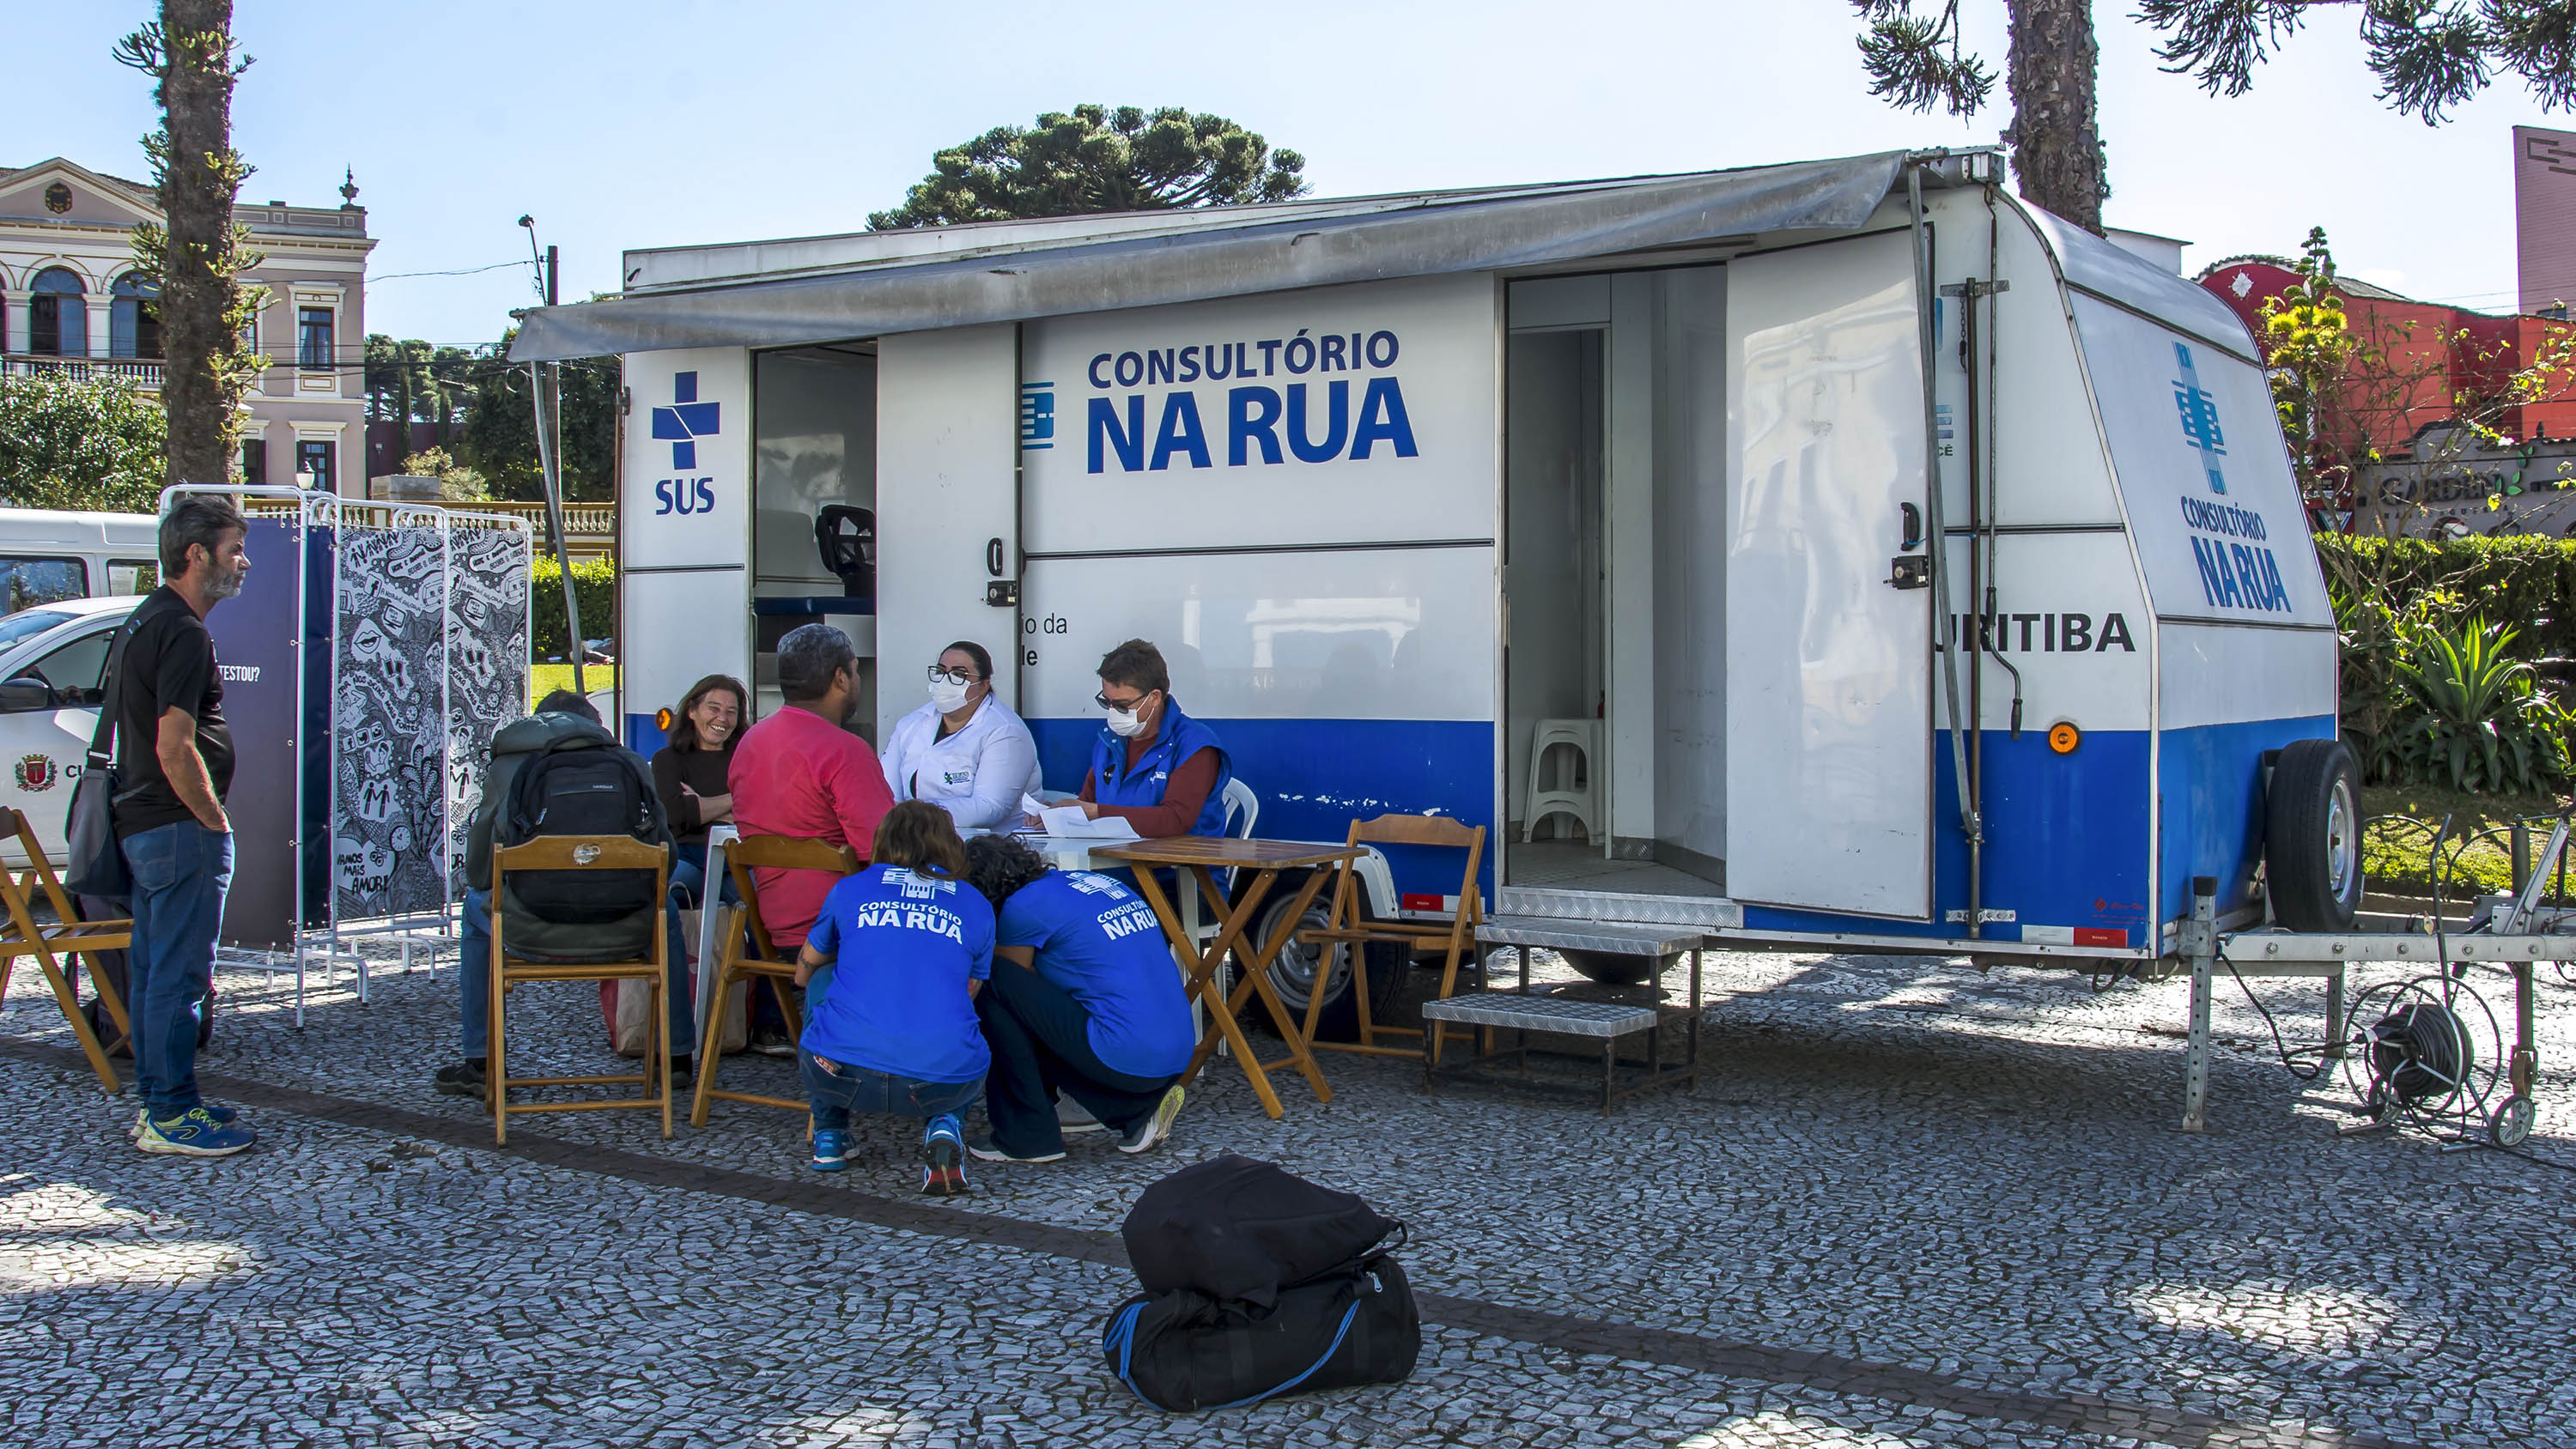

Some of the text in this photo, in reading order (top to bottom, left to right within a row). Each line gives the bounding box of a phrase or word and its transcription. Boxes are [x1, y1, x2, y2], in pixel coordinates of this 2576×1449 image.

[1088, 329, 1400, 389] CONSULTÓRIO
[1087, 376, 1419, 474] NA RUA
[655, 476, 715, 516] SUS
[2181, 495, 2267, 542] CONSULTÓRIO
[2190, 536, 2292, 613] NA RUA
[1043, 612, 1067, 634] da
[217, 664, 261, 682] TESTOU?
[857, 909, 963, 945] NA RUA
[859, 901, 963, 926] CONSULTÓRIO
[1102, 915, 1138, 941] NA
